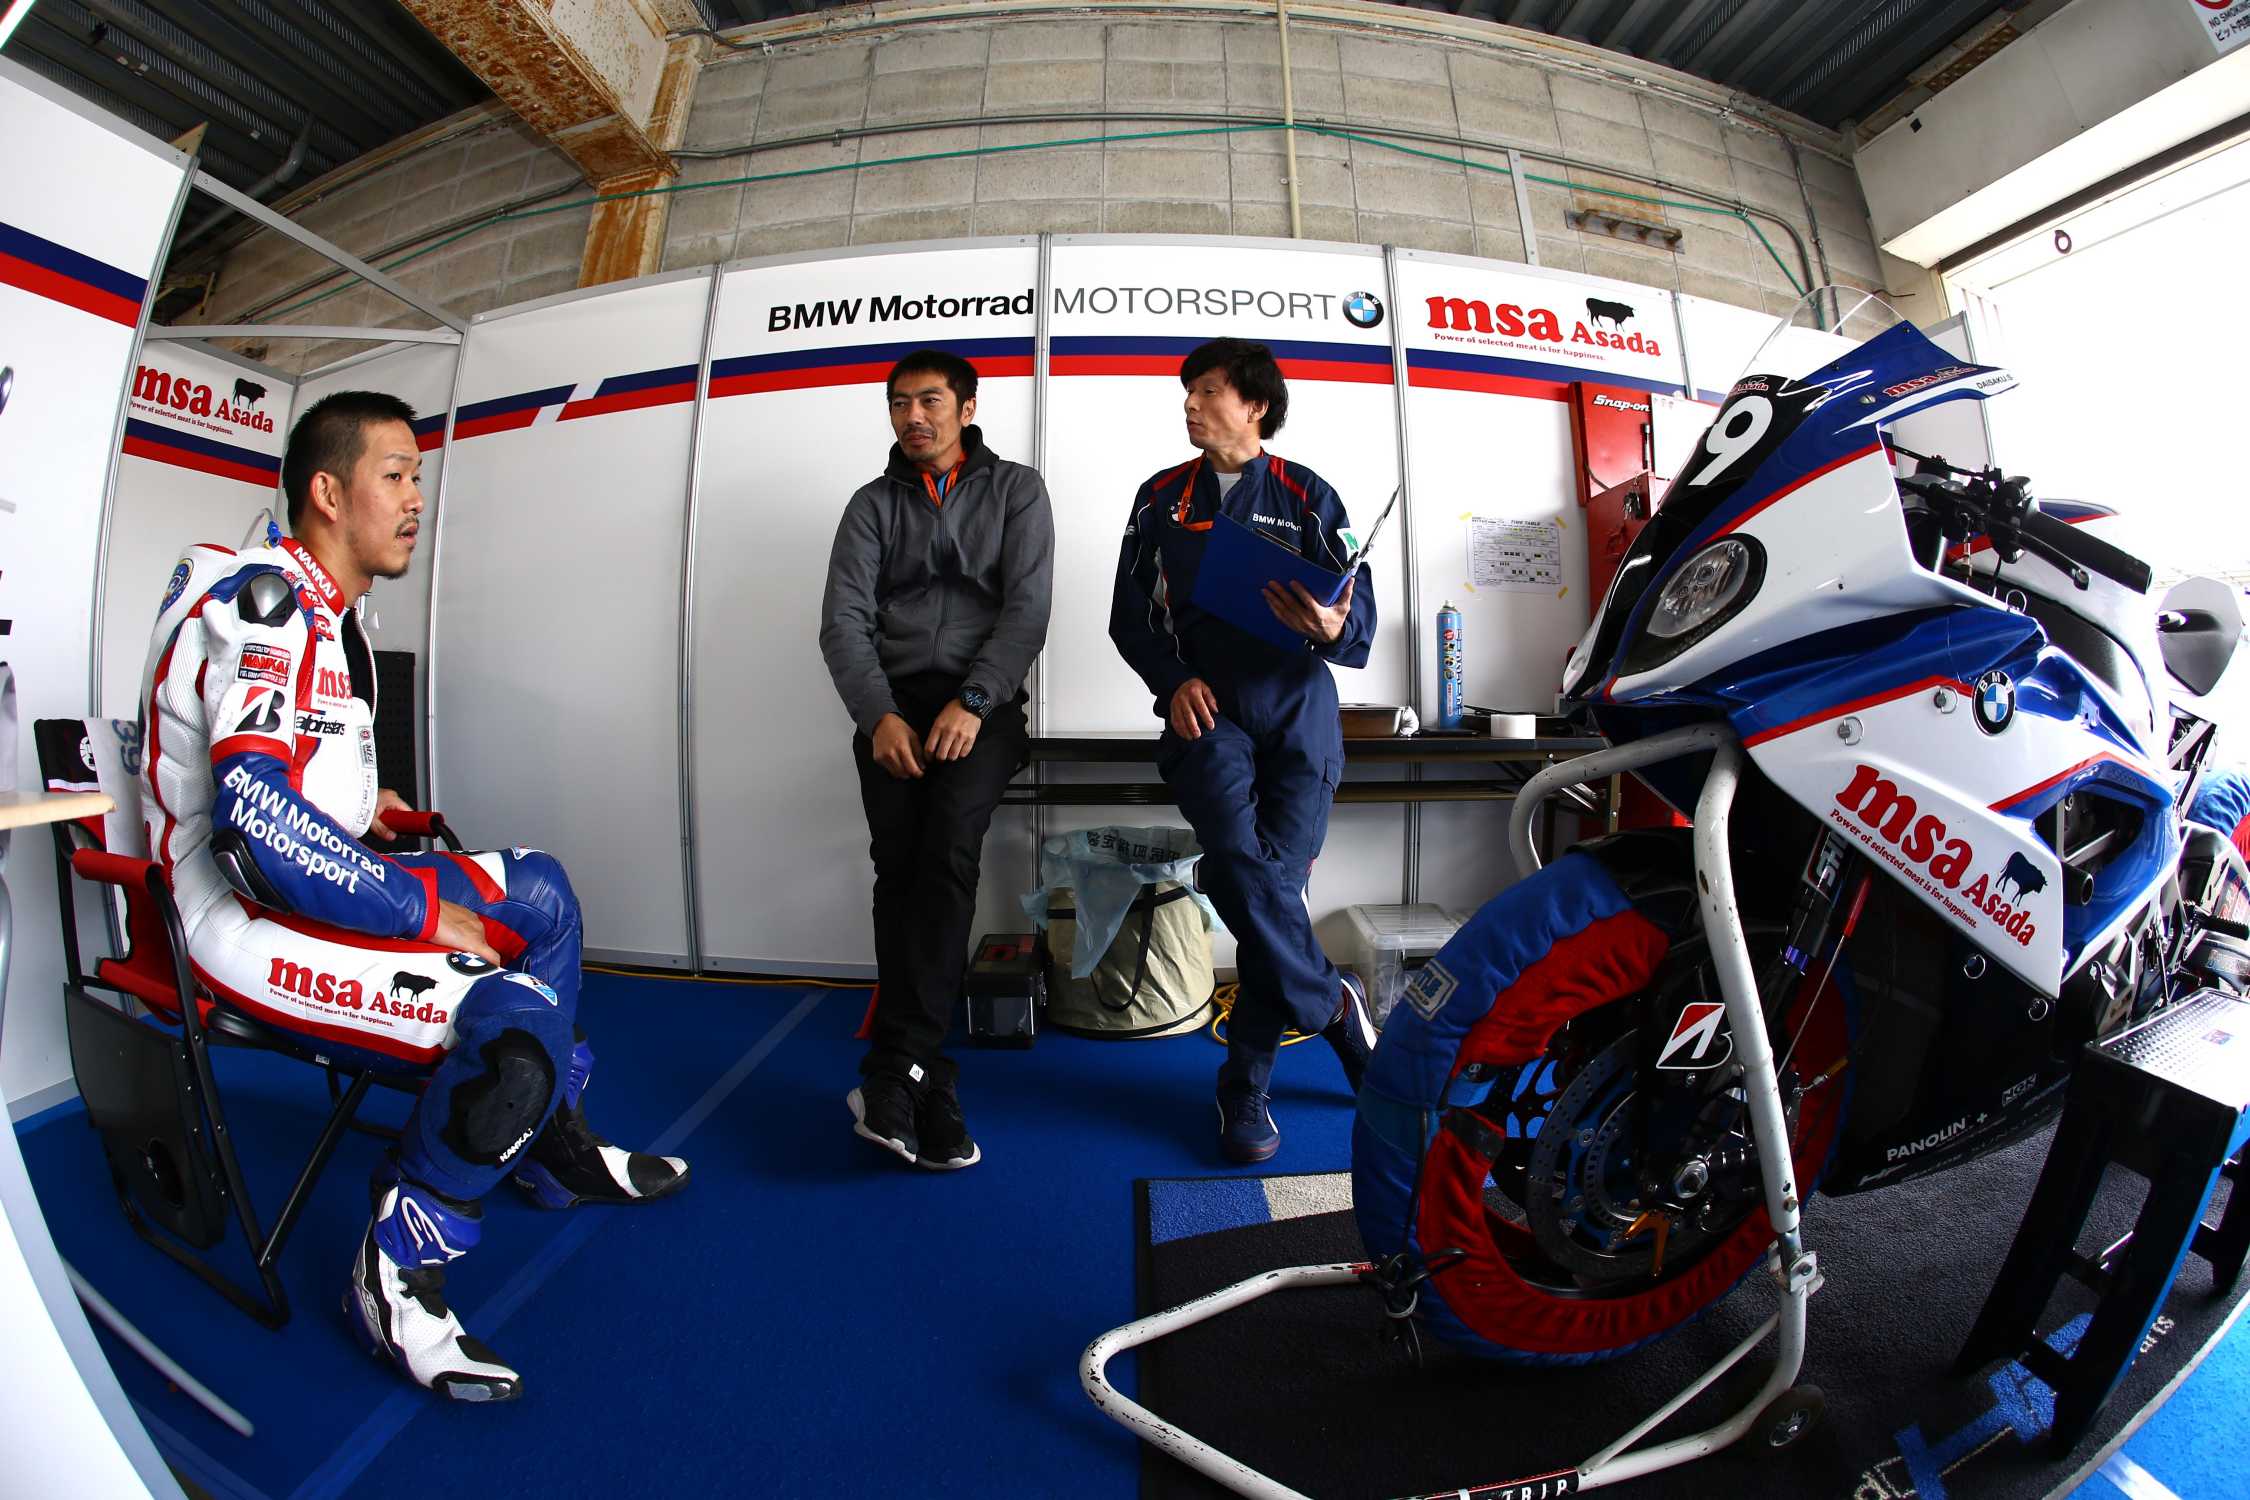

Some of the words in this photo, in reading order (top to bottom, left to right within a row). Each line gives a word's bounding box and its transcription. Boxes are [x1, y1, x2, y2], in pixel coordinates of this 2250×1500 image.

[768, 298, 862, 332] BMW
[868, 288, 1035, 323] Motorrad
[1054, 287, 1336, 320] MOTORSPORT
[1425, 296, 1564, 342] msa
[1570, 320, 1662, 356] Asada
[1433, 332, 1464, 343] Power
[1466, 335, 1476, 344] of
[1478, 336, 1514, 348] selected
[1515, 341, 1537, 351] meat
[1538, 344, 1547, 352] is
[1547, 345, 1561, 354] for
[1563, 347, 1607, 361] happiness.
[131, 365, 212, 417] msa
[214, 398, 274, 433] Asada
[1592, 394, 1650, 412] Snap-on
[1882, 375, 1936, 398] msa
[154, 408, 178, 420] selected
[177, 415, 191, 424] meat
[1688, 395, 1773, 486] 9
[1252, 513, 1276, 527] BMW
[224, 764, 288, 818] BMW
[285, 804, 385, 882] Motorrad
[230, 797, 360, 894] Motorsport
[1830, 808, 1862, 837] Power
[1860, 832, 1873, 845] of
[1870, 839, 1906, 870] selected
[1903, 865, 1926, 887] meat
[1924, 881, 1933, 892] is
[1930, 885, 1945, 902] for
[1943, 896, 1978, 929] happiness.
[1835, 764, 1973, 889] msa
[1961, 873, 2036, 946] Asada
[267, 957, 363, 1010] msa
[369, 991, 448, 1024] Asada
[269, 987, 290, 1000] Power
[290, 996, 297, 1004] of
[298, 998, 323, 1012] selected
[324, 1007, 341, 1016] meat
[348, 1010, 360, 1019] for
[360, 1013, 395, 1028] happiness.
[1886, 1117, 1966, 1162] PANOLIN
